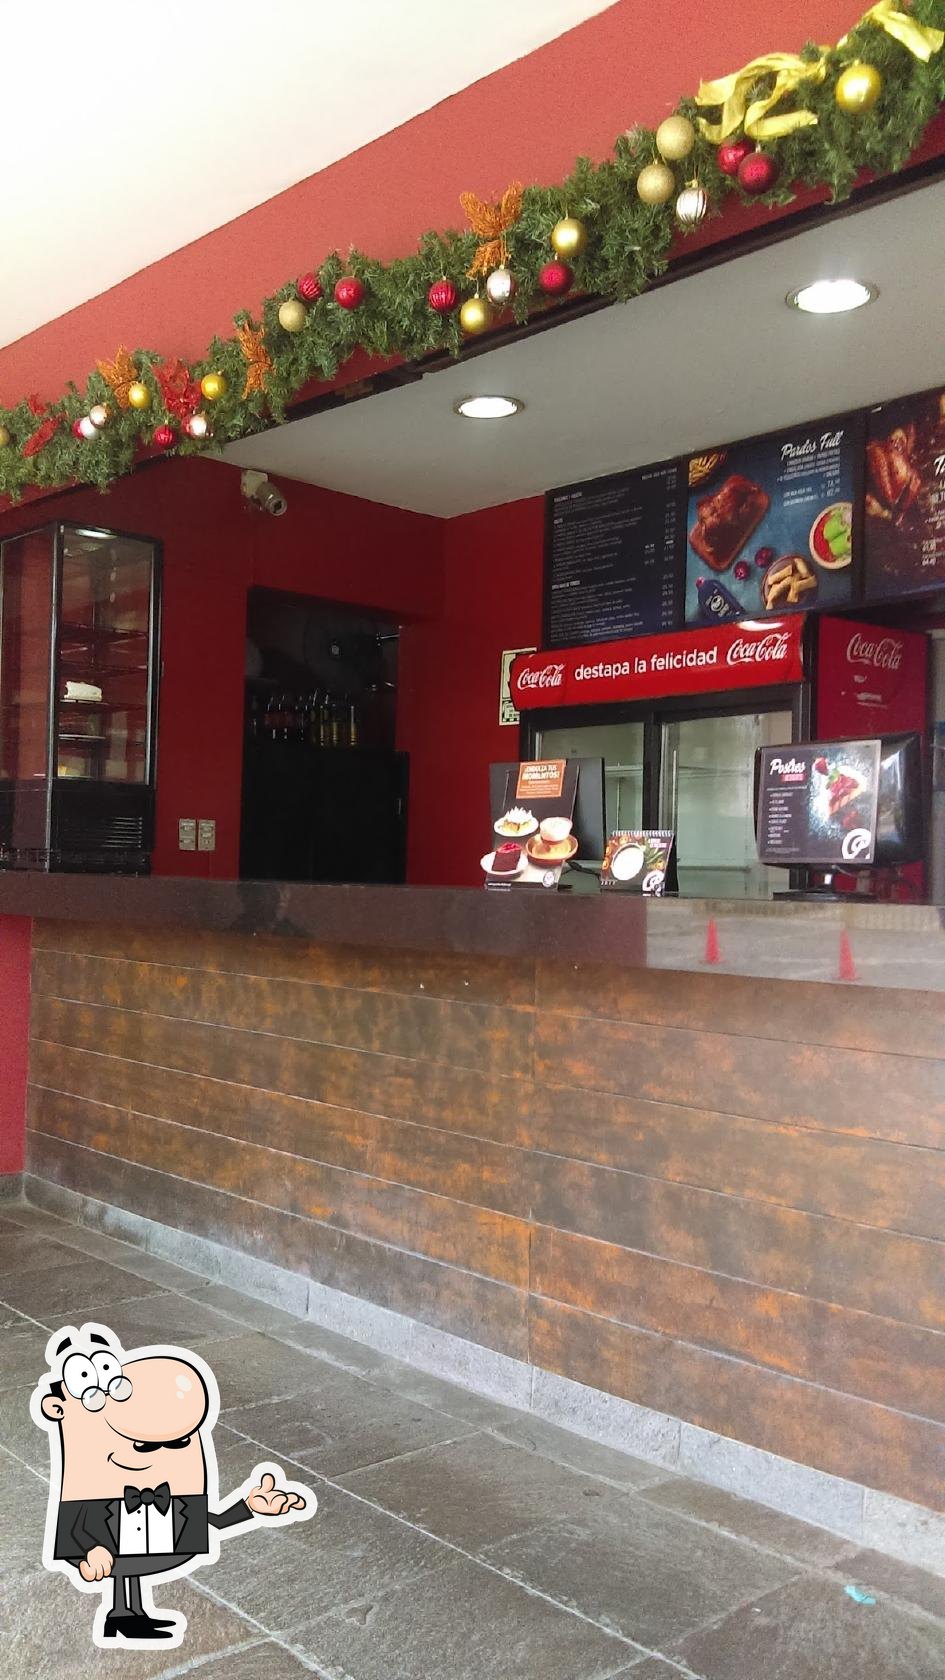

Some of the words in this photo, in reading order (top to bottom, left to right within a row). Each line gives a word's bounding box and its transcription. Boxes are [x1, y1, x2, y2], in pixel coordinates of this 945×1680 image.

[781, 439, 817, 460] Pardos
[820, 430, 844, 450] Full
[575, 661, 630, 680] destapa
[634, 657, 647, 673] la
[650, 647, 718, 672] felicidad
[769, 758, 806, 775] Postres
